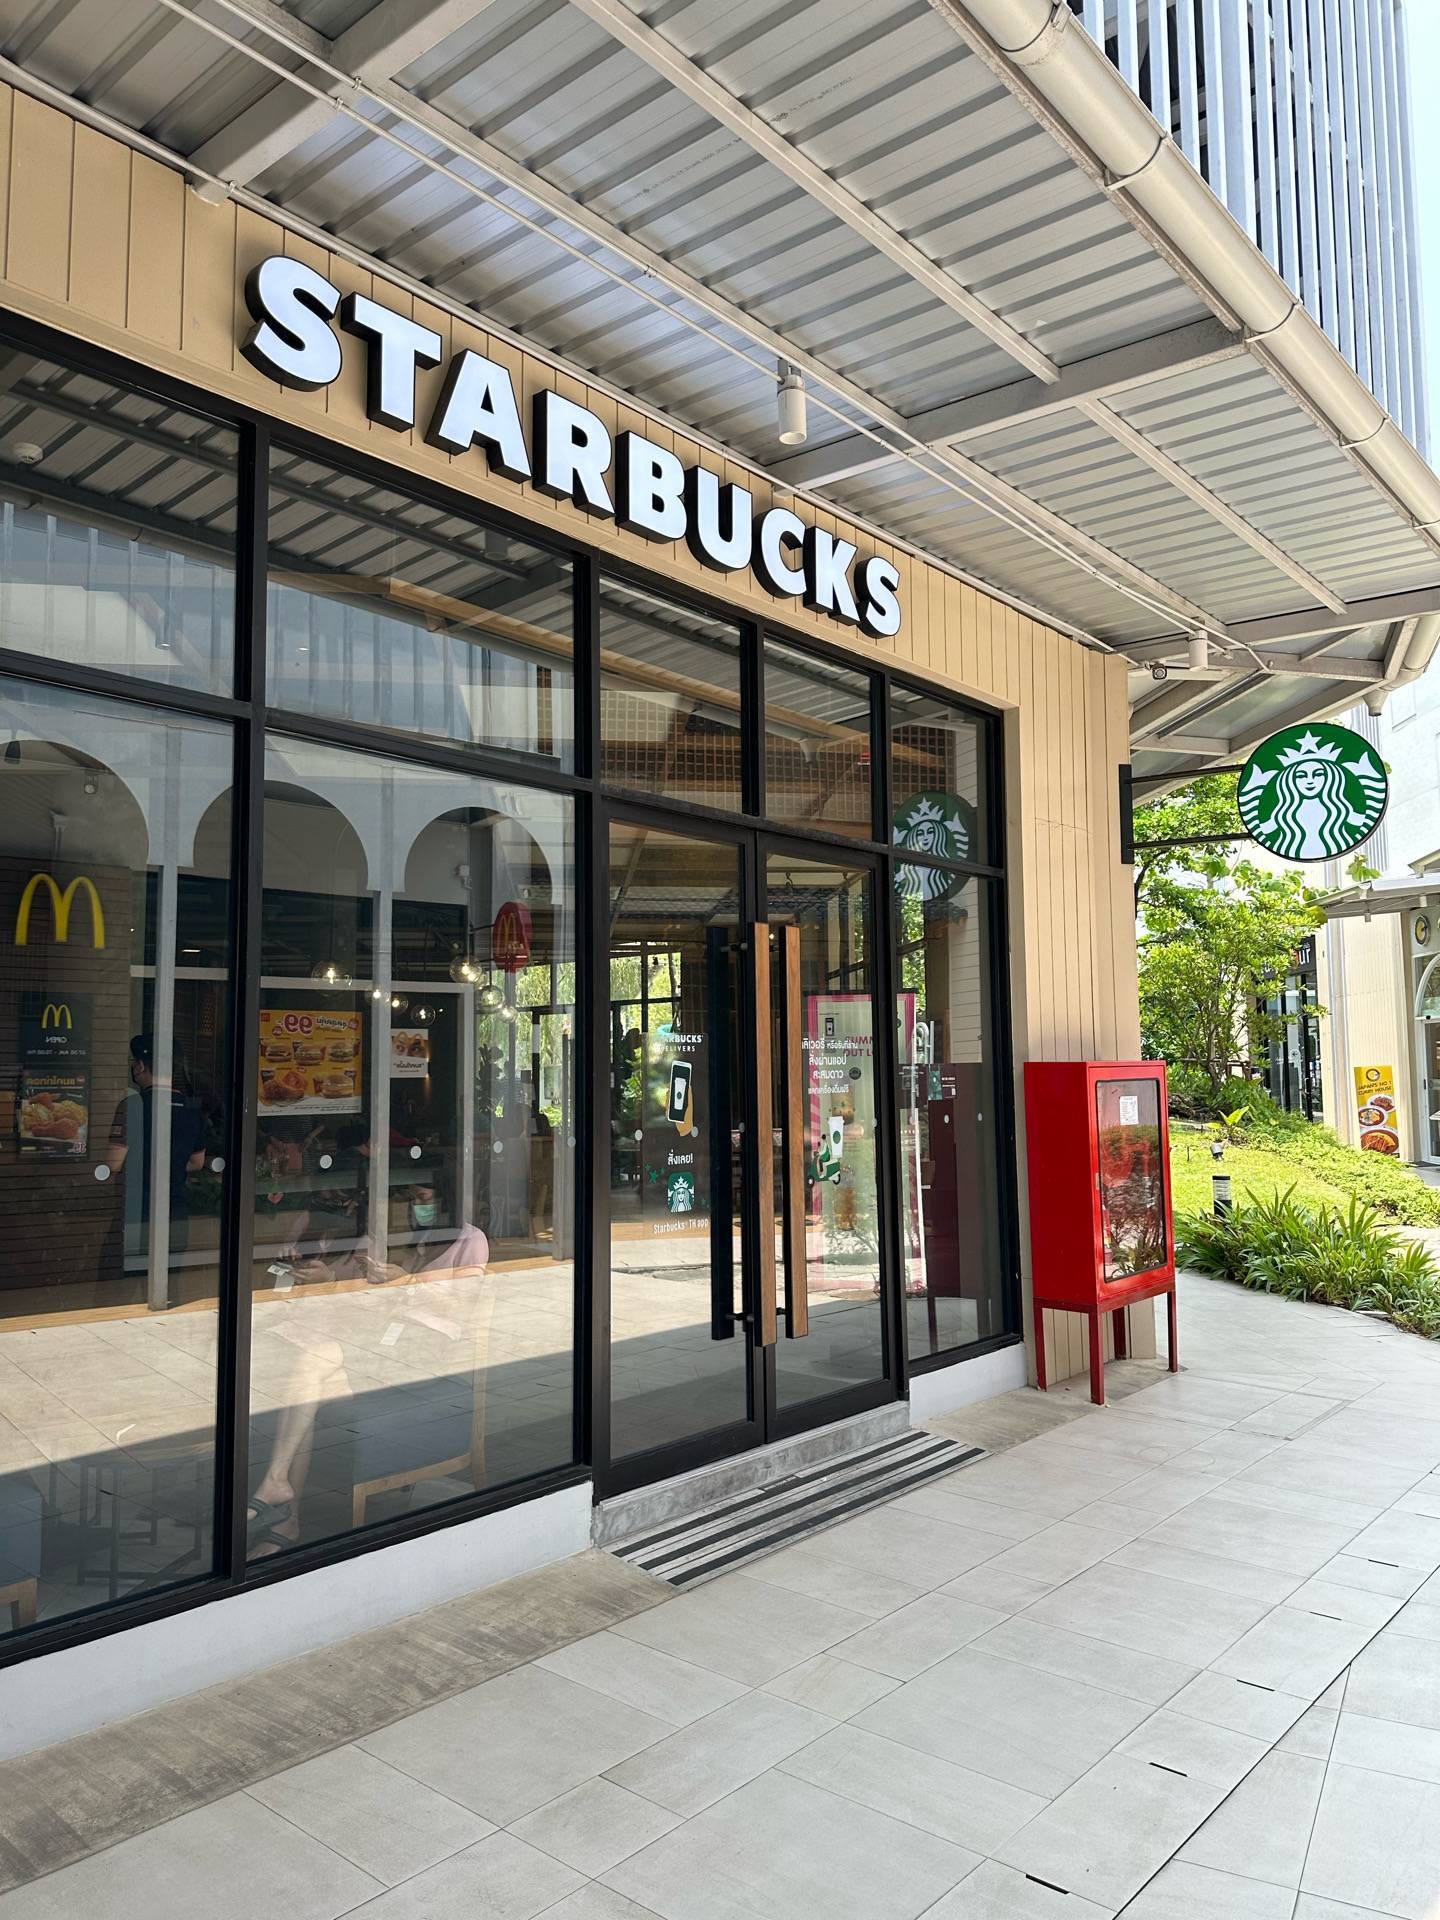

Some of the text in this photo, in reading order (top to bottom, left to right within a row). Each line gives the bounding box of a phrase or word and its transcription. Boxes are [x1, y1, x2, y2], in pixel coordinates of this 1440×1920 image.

[243, 255, 901, 638] STARBUCKS
[667, 1148, 694, 1166] สั่งเลย!
